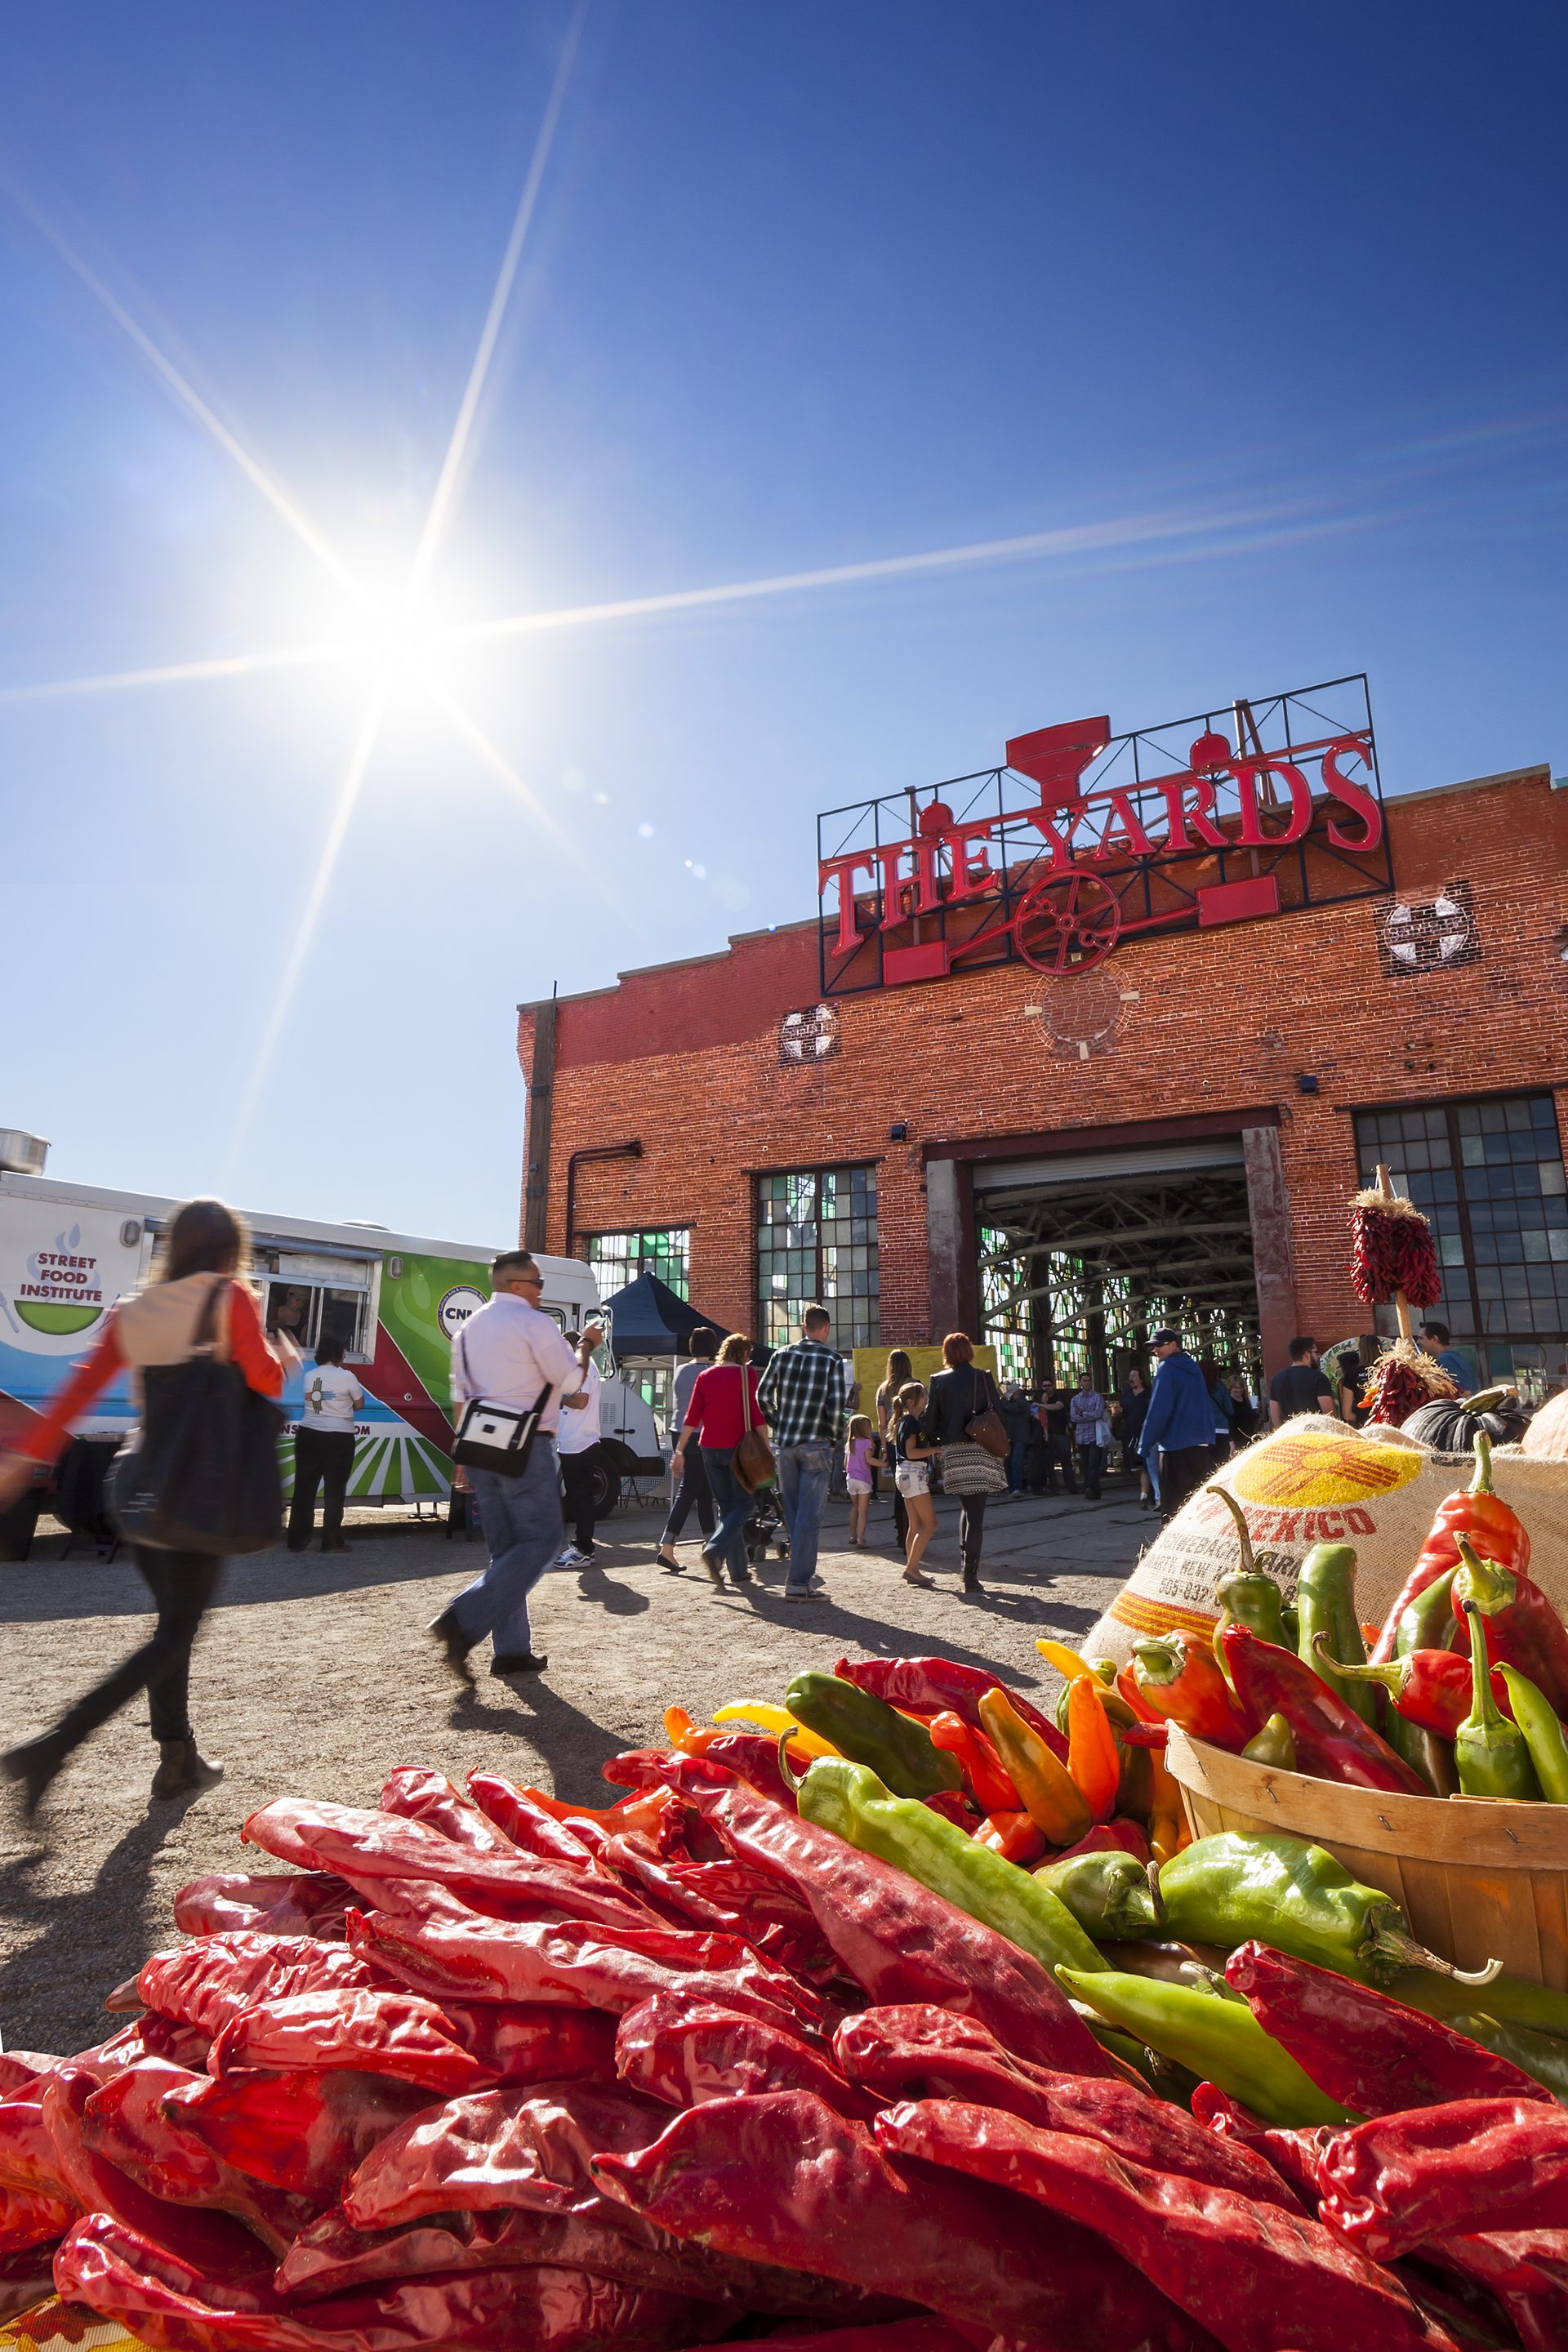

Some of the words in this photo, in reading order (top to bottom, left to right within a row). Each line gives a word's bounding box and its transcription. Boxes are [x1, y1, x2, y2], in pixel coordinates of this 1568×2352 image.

[819, 826, 1000, 958] THE
[1028, 739, 1383, 873] YARDS
[38, 1253, 96, 1268] STREET
[41, 1270, 87, 1284] FOOD
[20, 1284, 102, 1302] INSTITUTE
[1219, 1507, 1377, 1542] MEXICO
